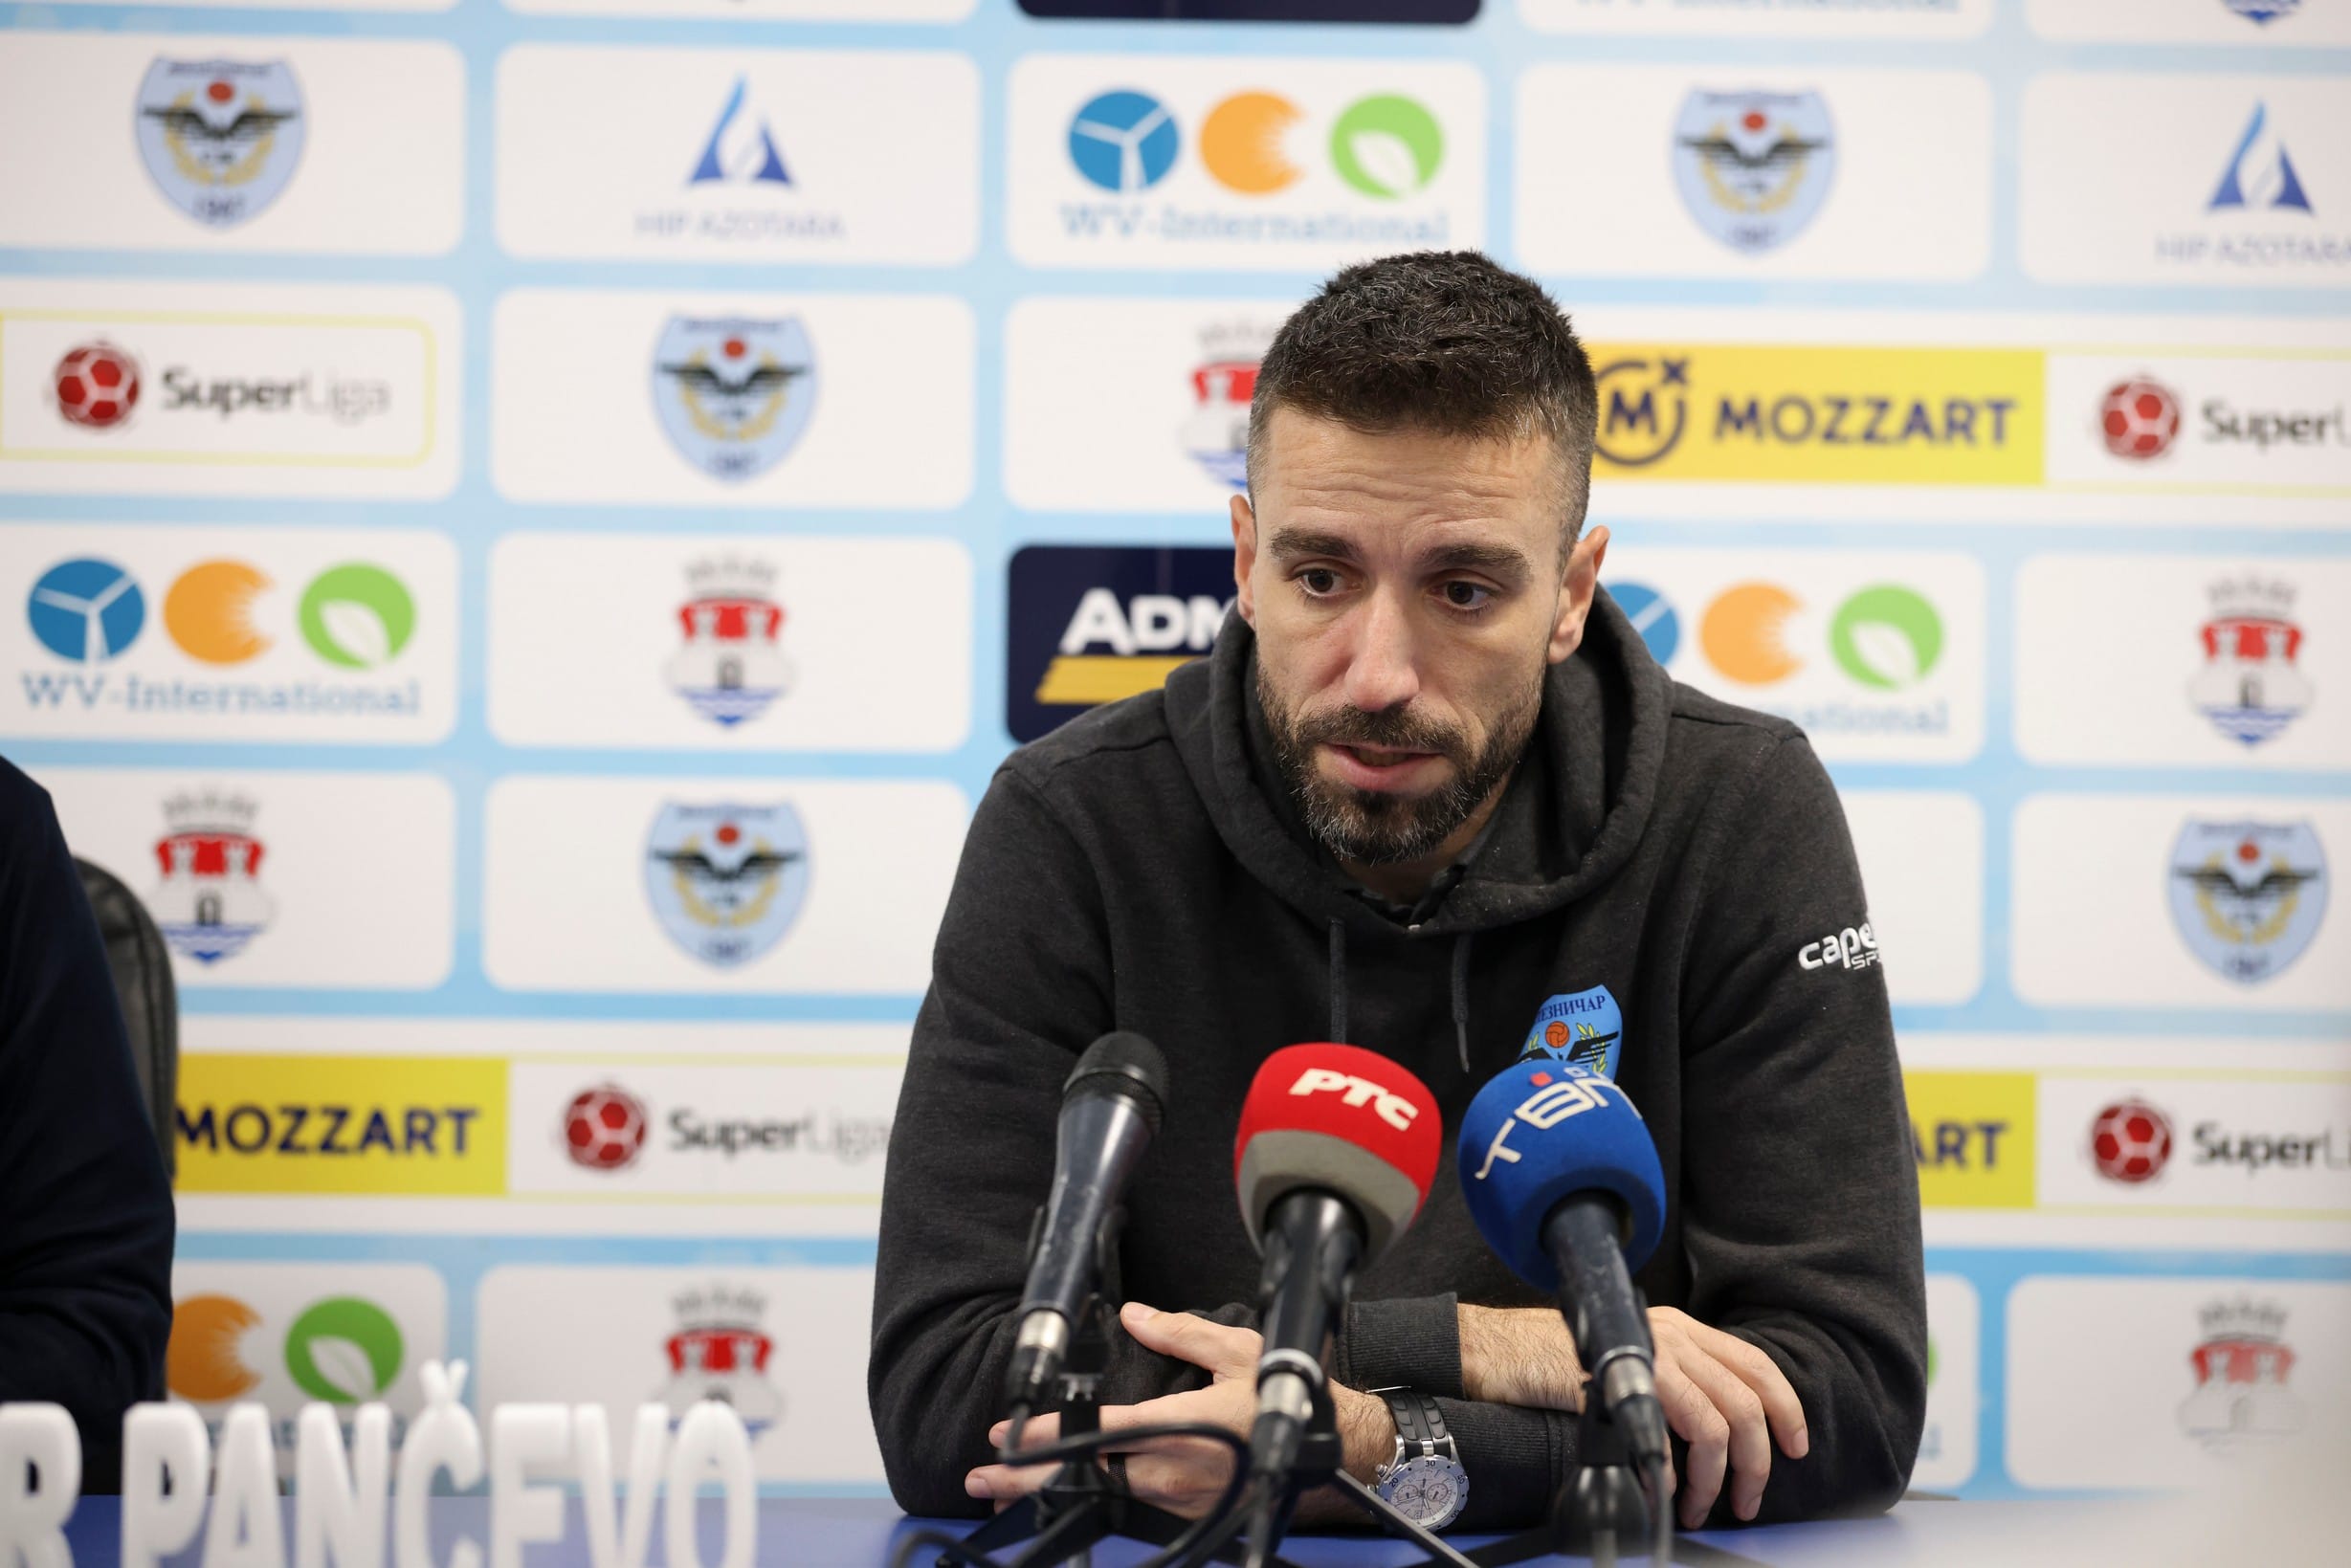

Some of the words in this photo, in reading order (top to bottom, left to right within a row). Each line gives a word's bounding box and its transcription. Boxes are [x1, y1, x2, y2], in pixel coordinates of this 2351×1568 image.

[1058, 202, 1451, 242] WV-International
[161, 365, 391, 427] SuperLiga
[1716, 394, 2016, 446] MOZZART
[20, 672, 420, 716] WV-International
[176, 1105, 478, 1156] MOZZART
[122, 1359, 757, 1568] PANČEVO
